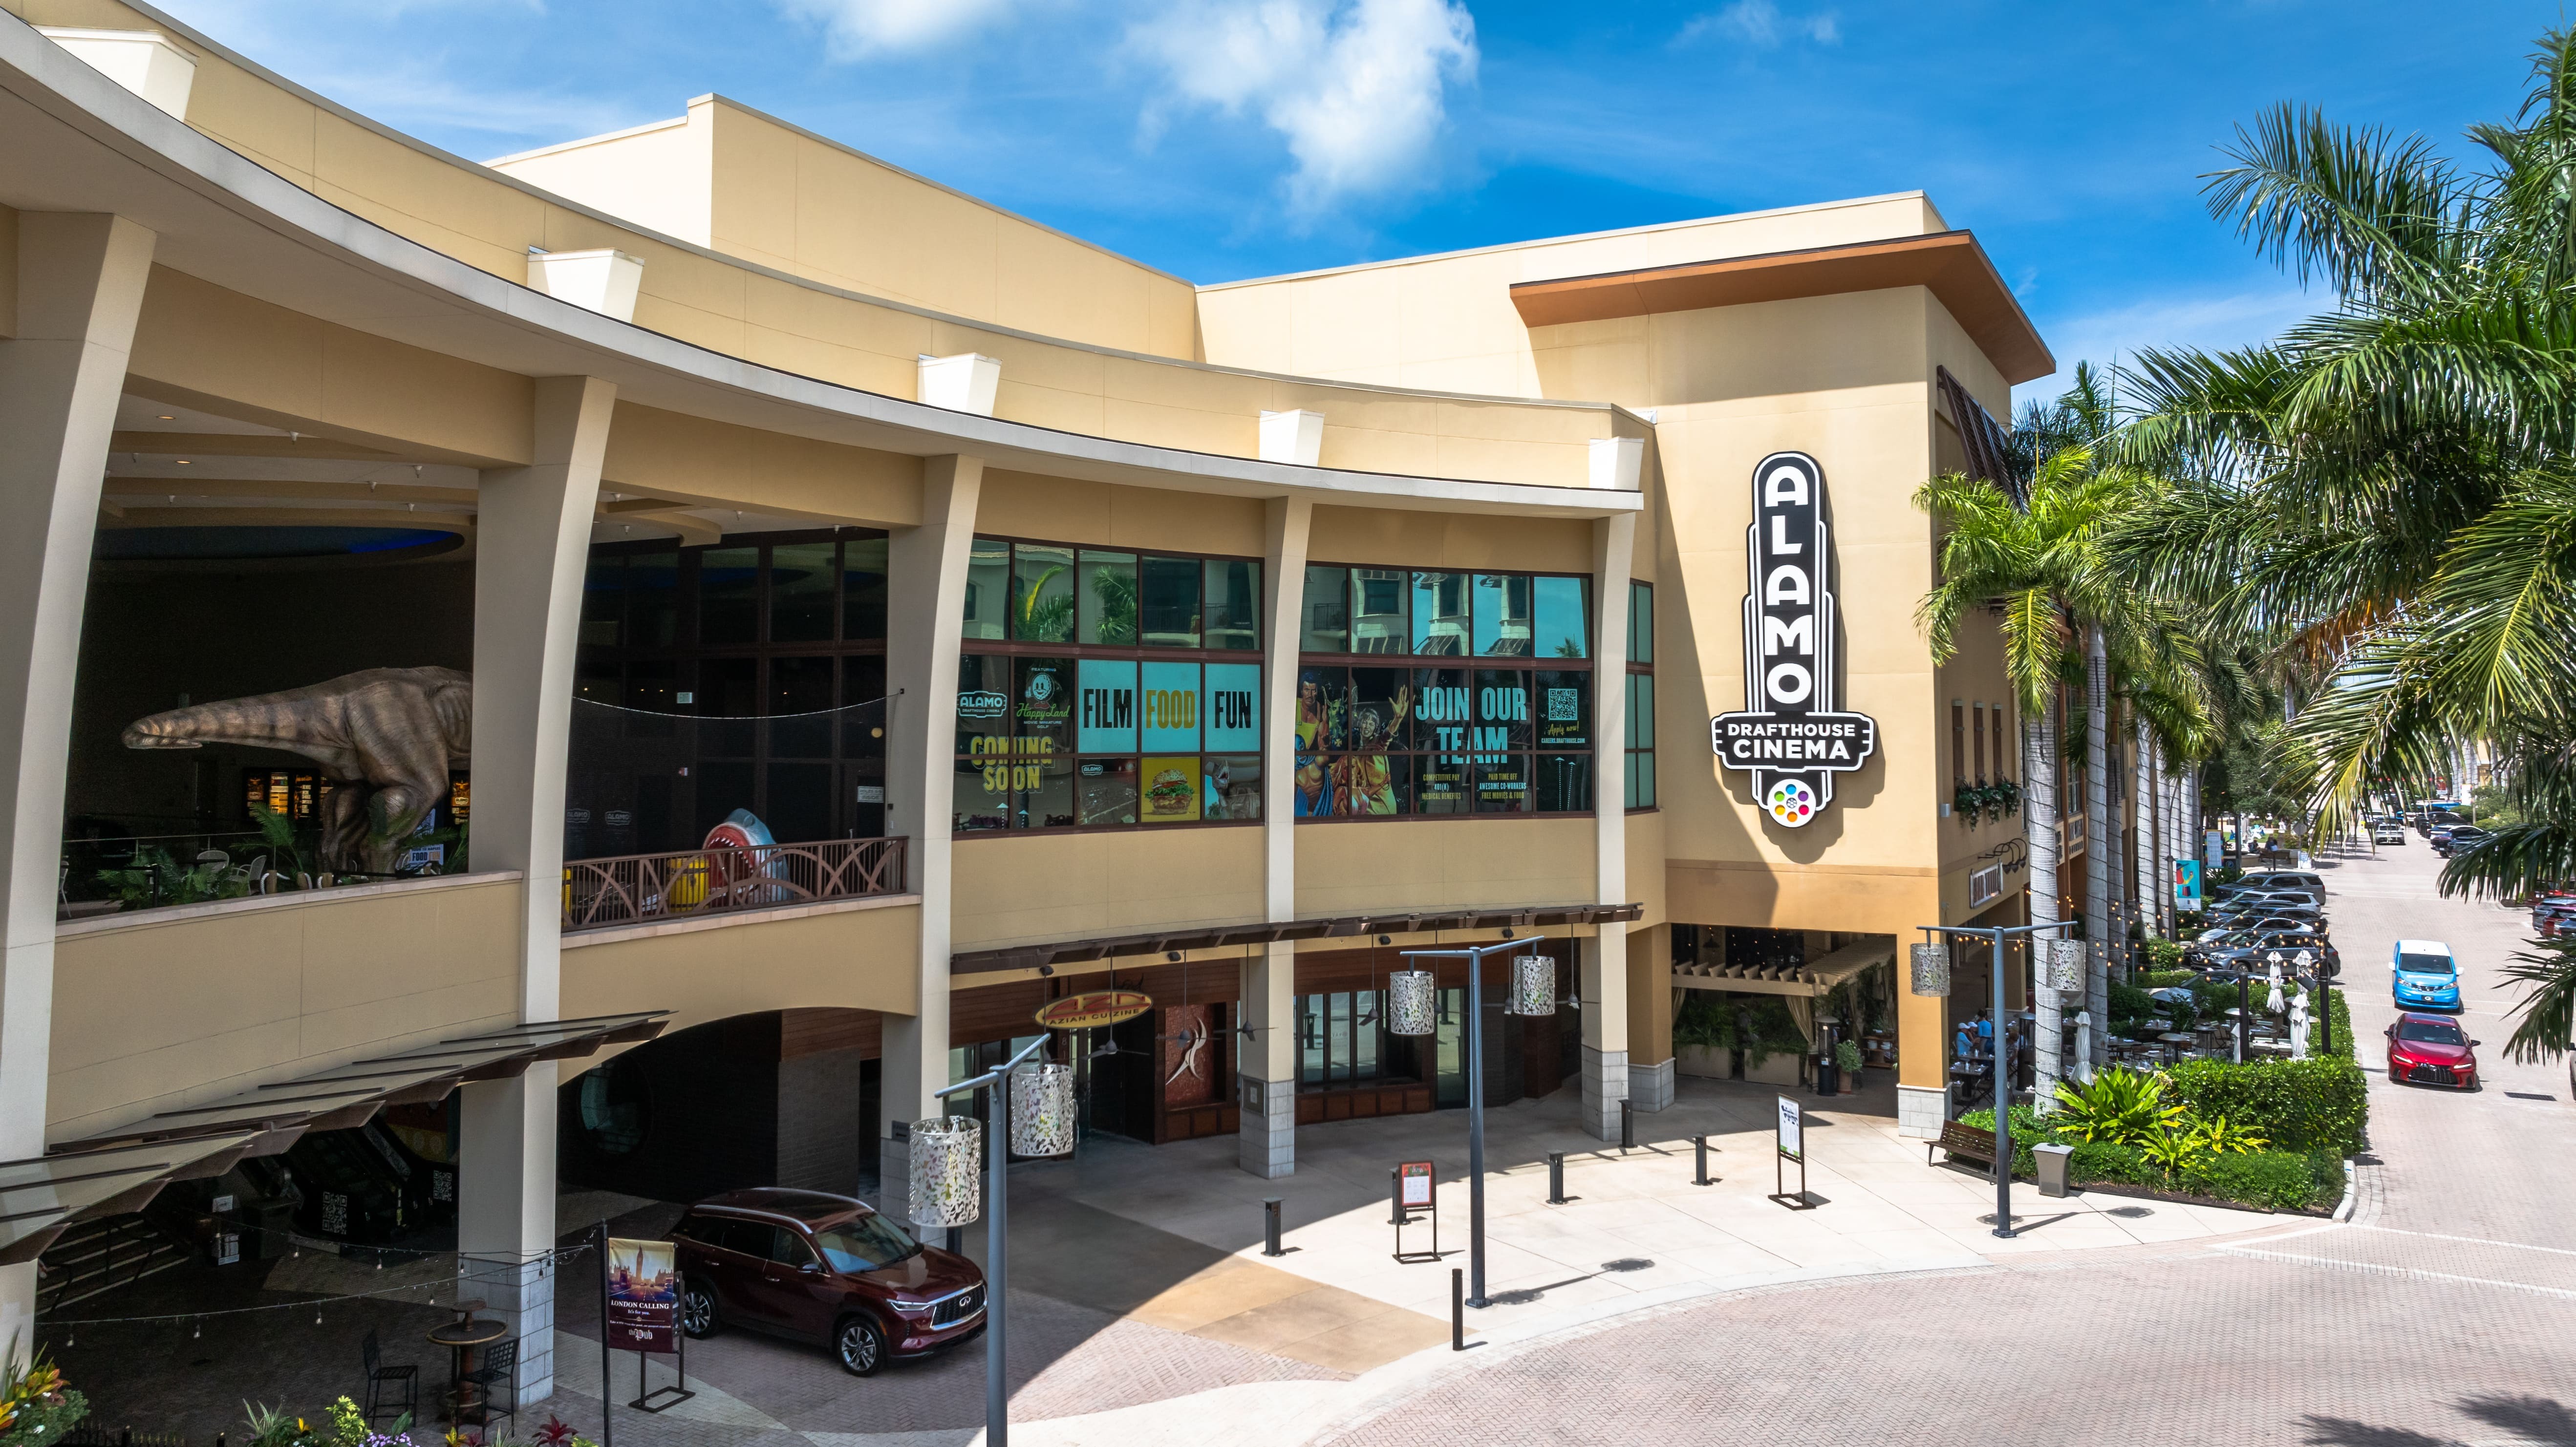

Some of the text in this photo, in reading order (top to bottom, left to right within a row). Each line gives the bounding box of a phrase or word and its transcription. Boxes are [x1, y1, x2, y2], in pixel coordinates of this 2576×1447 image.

[1764, 465, 1813, 704] ALAMO
[960, 696, 1003, 707] ALAMO
[1083, 689, 1132, 729] FILM
[1146, 689, 1196, 729] FOOD
[1215, 691, 1251, 729] FUN
[1416, 687, 1527, 721] JOIN OUR
[1547, 721, 1580, 737] Apply now!
[1727, 723, 1856, 738] DRAFTHOUSE
[970, 736, 1053, 766] COMING
[1437, 727, 1508, 765] TEAM
[1733, 739, 1850, 760] CINEMA
[983, 766, 1041, 791] SOON
[1423, 773, 1451, 782] COMPETITIVE
[1434, 783, 1449, 792] 401(K)
[412, 851, 440, 861] FOOD FUN
[1048, 993, 1146, 1014] AZN
[1049, 1016, 1086, 1025] AZIAN
[611, 1299, 638, 1308] LONDON
